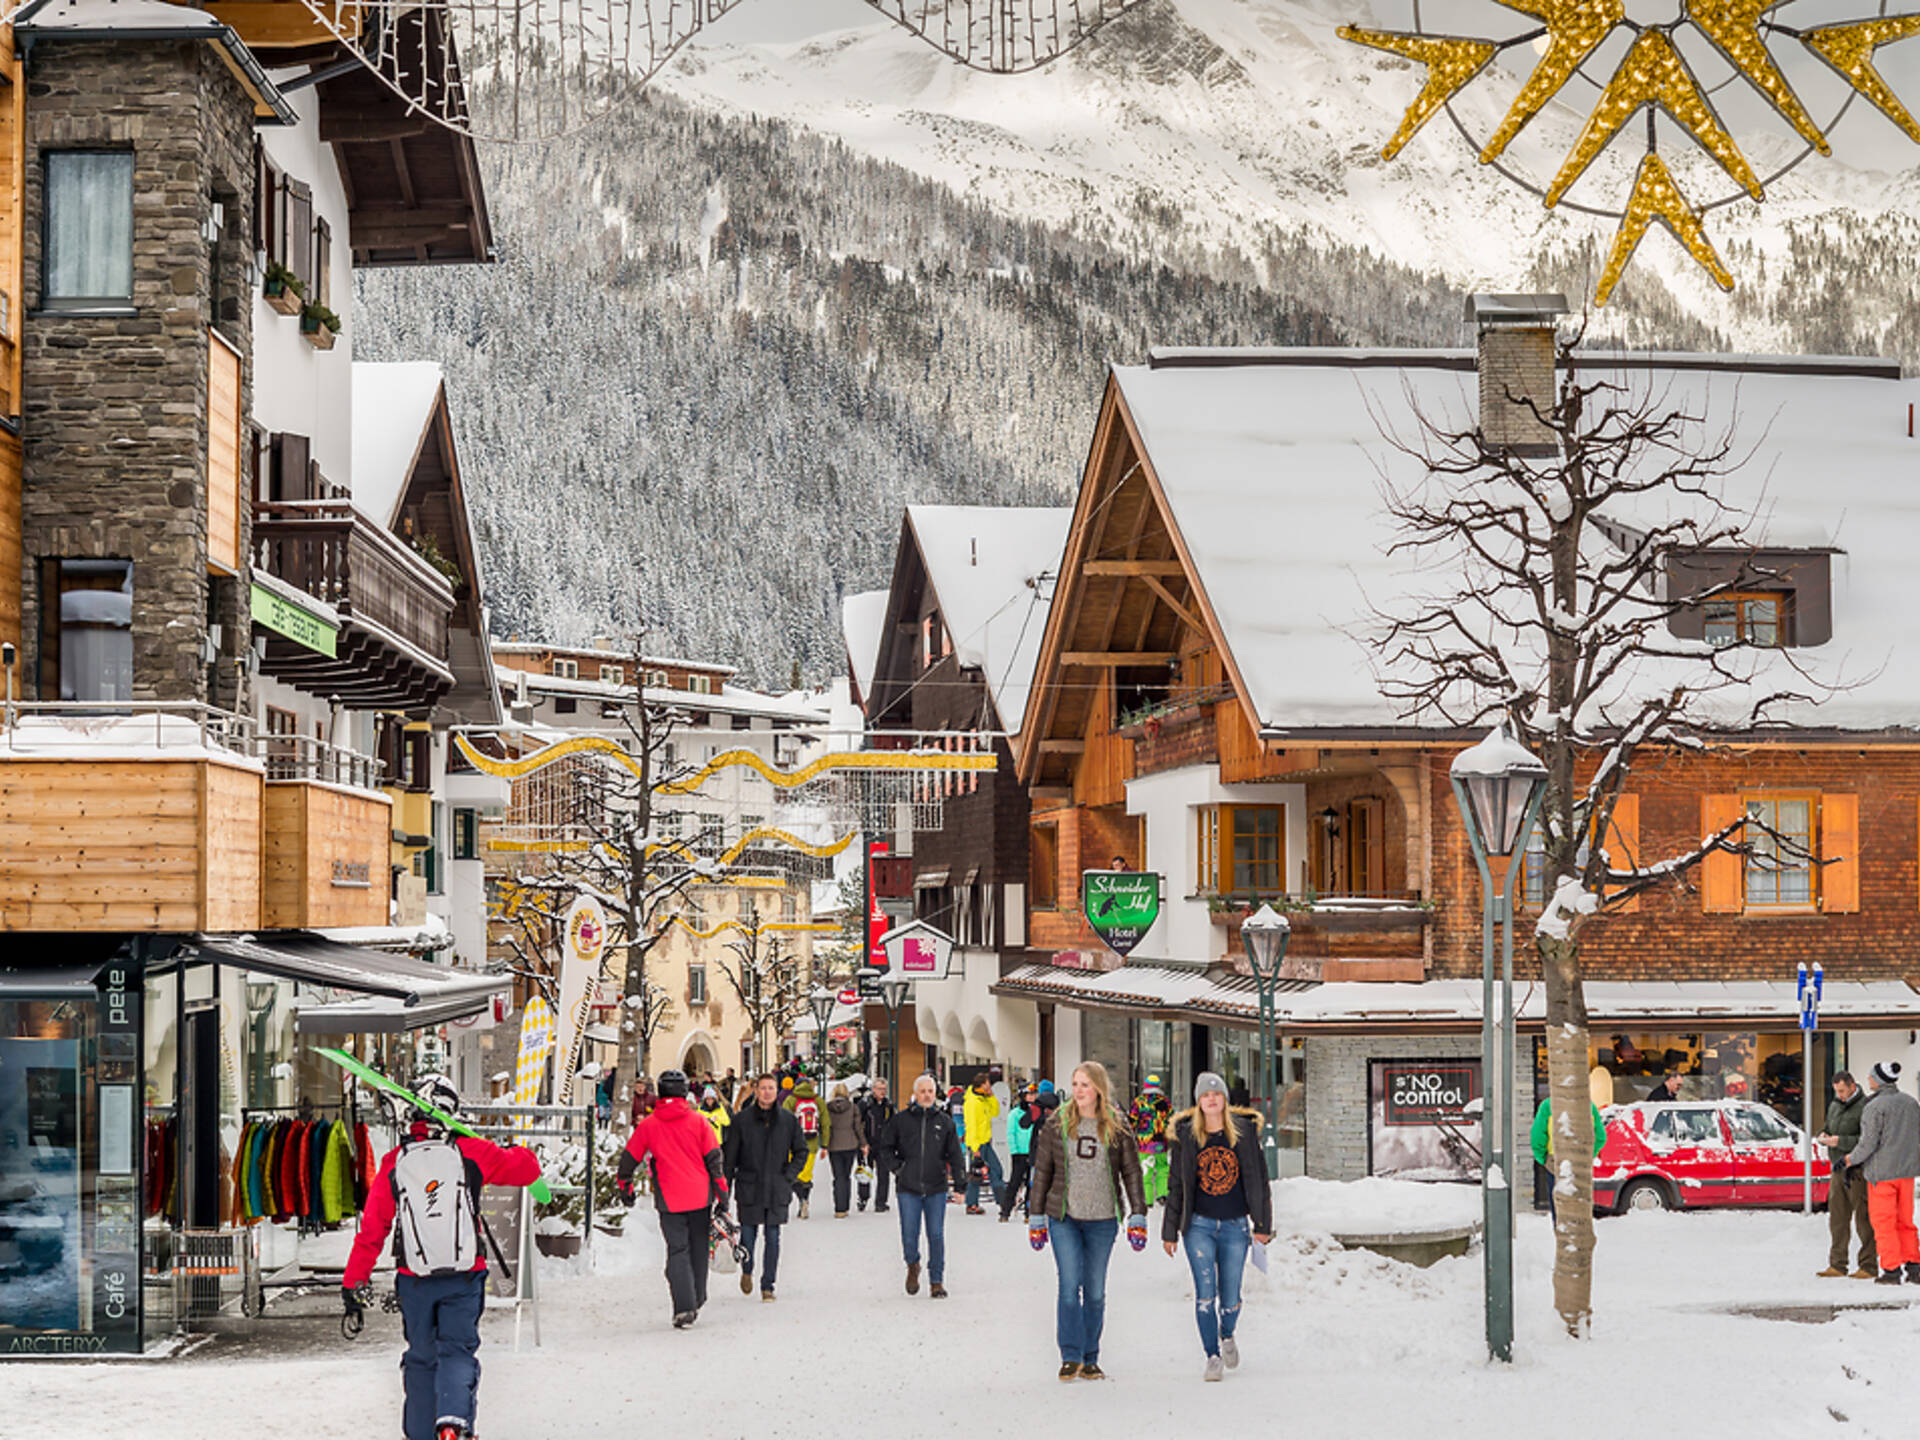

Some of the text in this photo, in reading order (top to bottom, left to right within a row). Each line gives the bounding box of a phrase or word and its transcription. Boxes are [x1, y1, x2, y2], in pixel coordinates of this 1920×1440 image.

[1090, 876, 1151, 893] Schneider
[1123, 894, 1152, 912] Hof
[1108, 926, 1138, 939] Hotel
[105, 969, 129, 1025] pete
[1393, 1087, 1463, 1105] control
[1076, 1135, 1097, 1159] G
[103, 1272, 126, 1319] Café
[9, 1335, 108, 1353] ARC'TERYX
